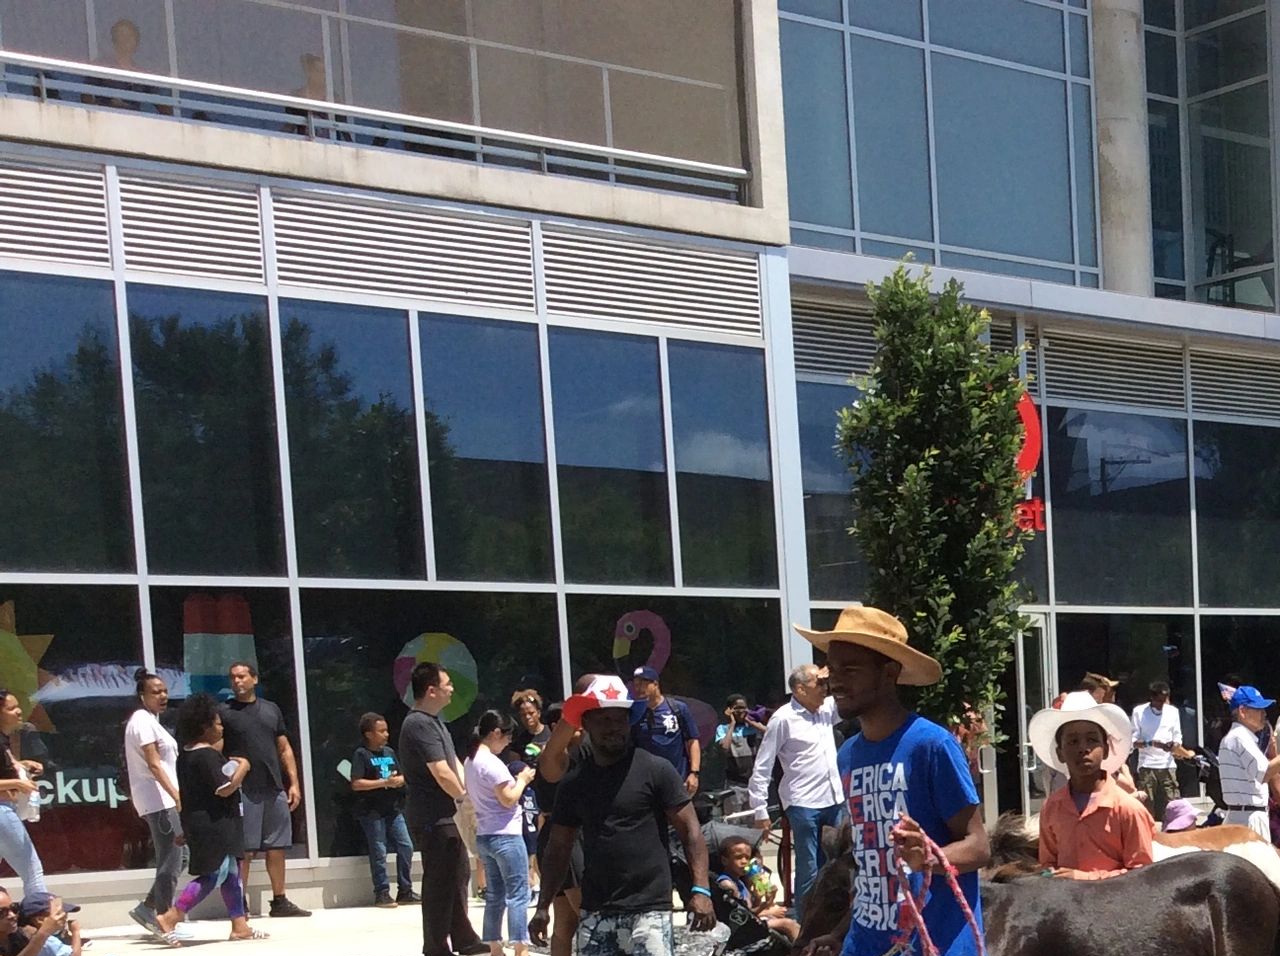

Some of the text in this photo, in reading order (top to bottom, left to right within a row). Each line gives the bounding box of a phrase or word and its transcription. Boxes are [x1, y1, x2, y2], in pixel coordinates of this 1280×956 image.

[38, 771, 128, 808] ckup
[843, 763, 908, 797] ERICA
[847, 791, 909, 825] ERICA
